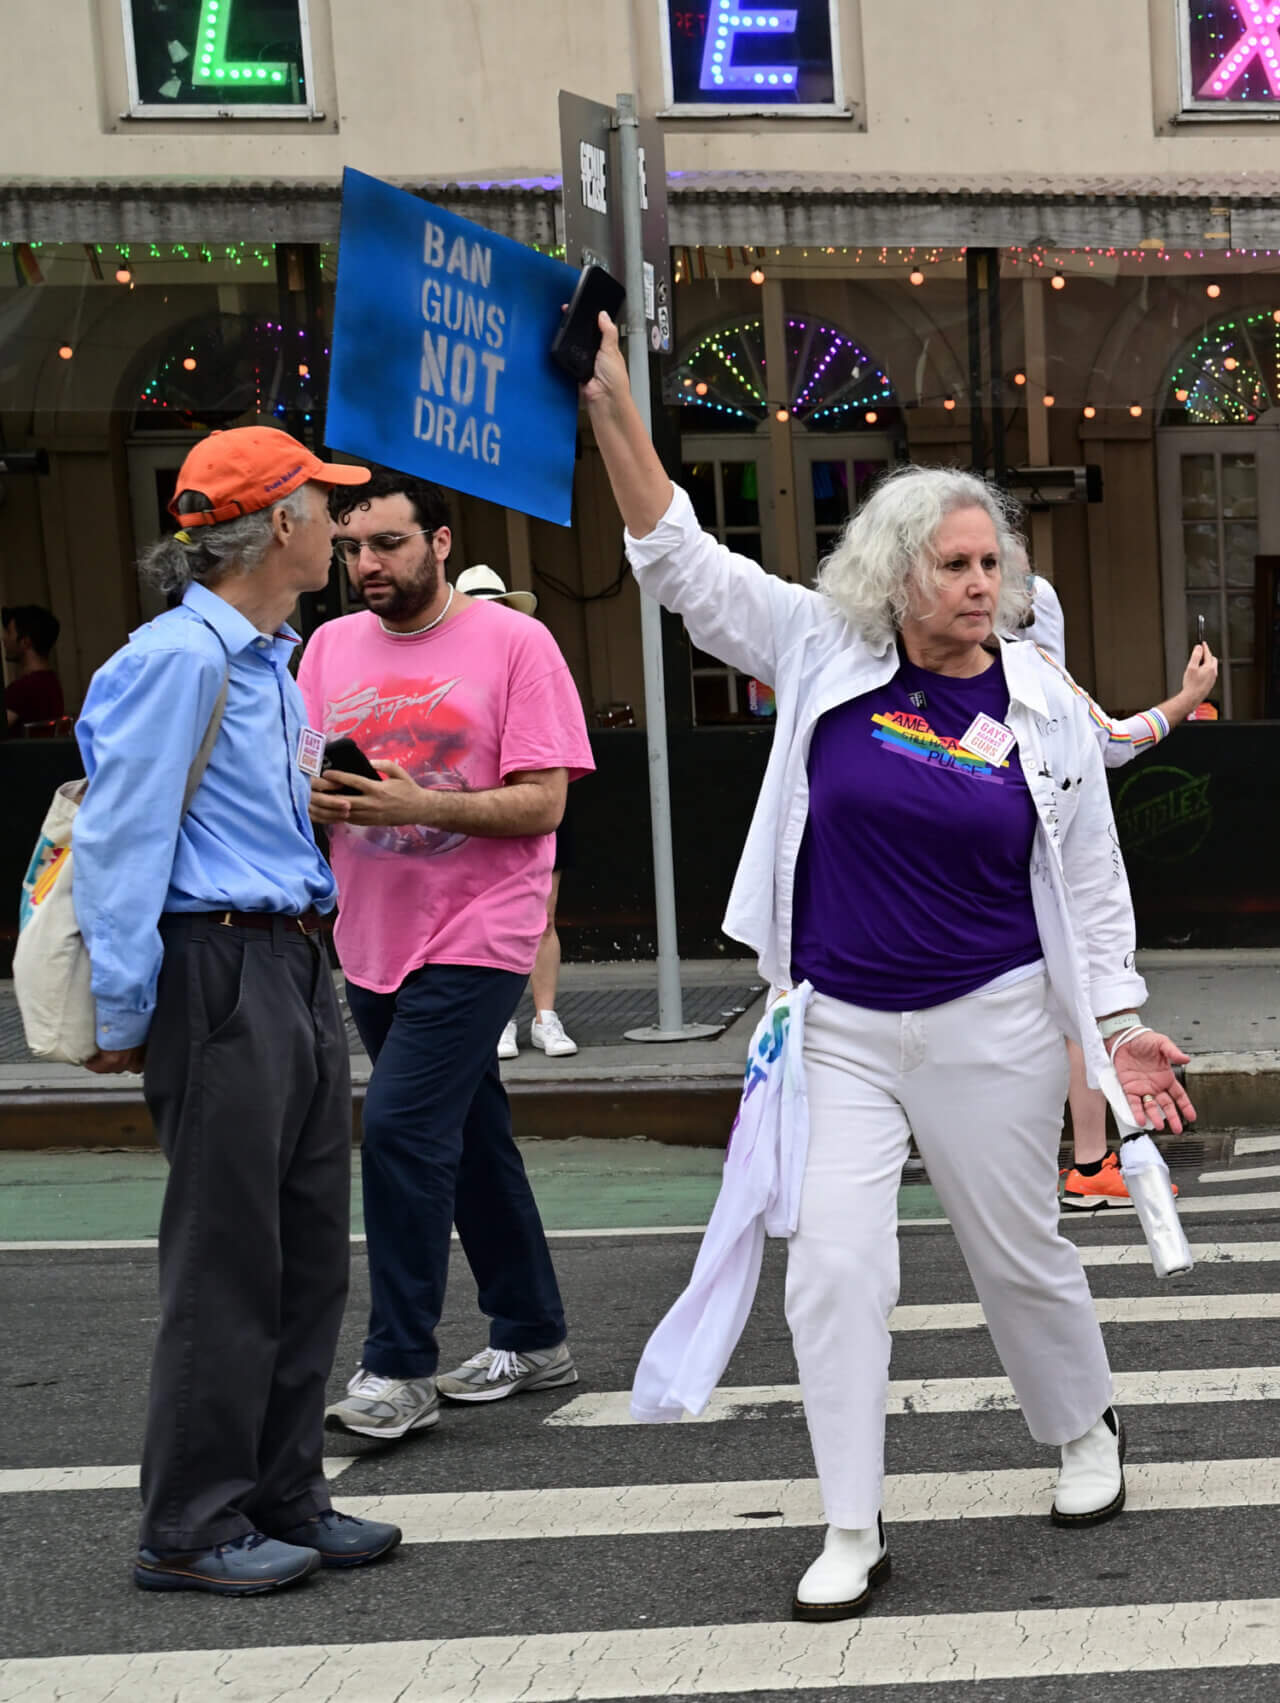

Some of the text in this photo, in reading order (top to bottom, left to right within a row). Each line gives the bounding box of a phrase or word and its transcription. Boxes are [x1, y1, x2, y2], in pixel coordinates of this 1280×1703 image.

[423, 220, 492, 288] BAN
[421, 277, 505, 349] GUNS
[420, 330, 505, 415] NOT
[413, 396, 502, 467] DRAG
[927, 750, 984, 778] PULSE
[971, 736, 998, 757] GUNS
[980, 722, 1008, 743] GAYS
